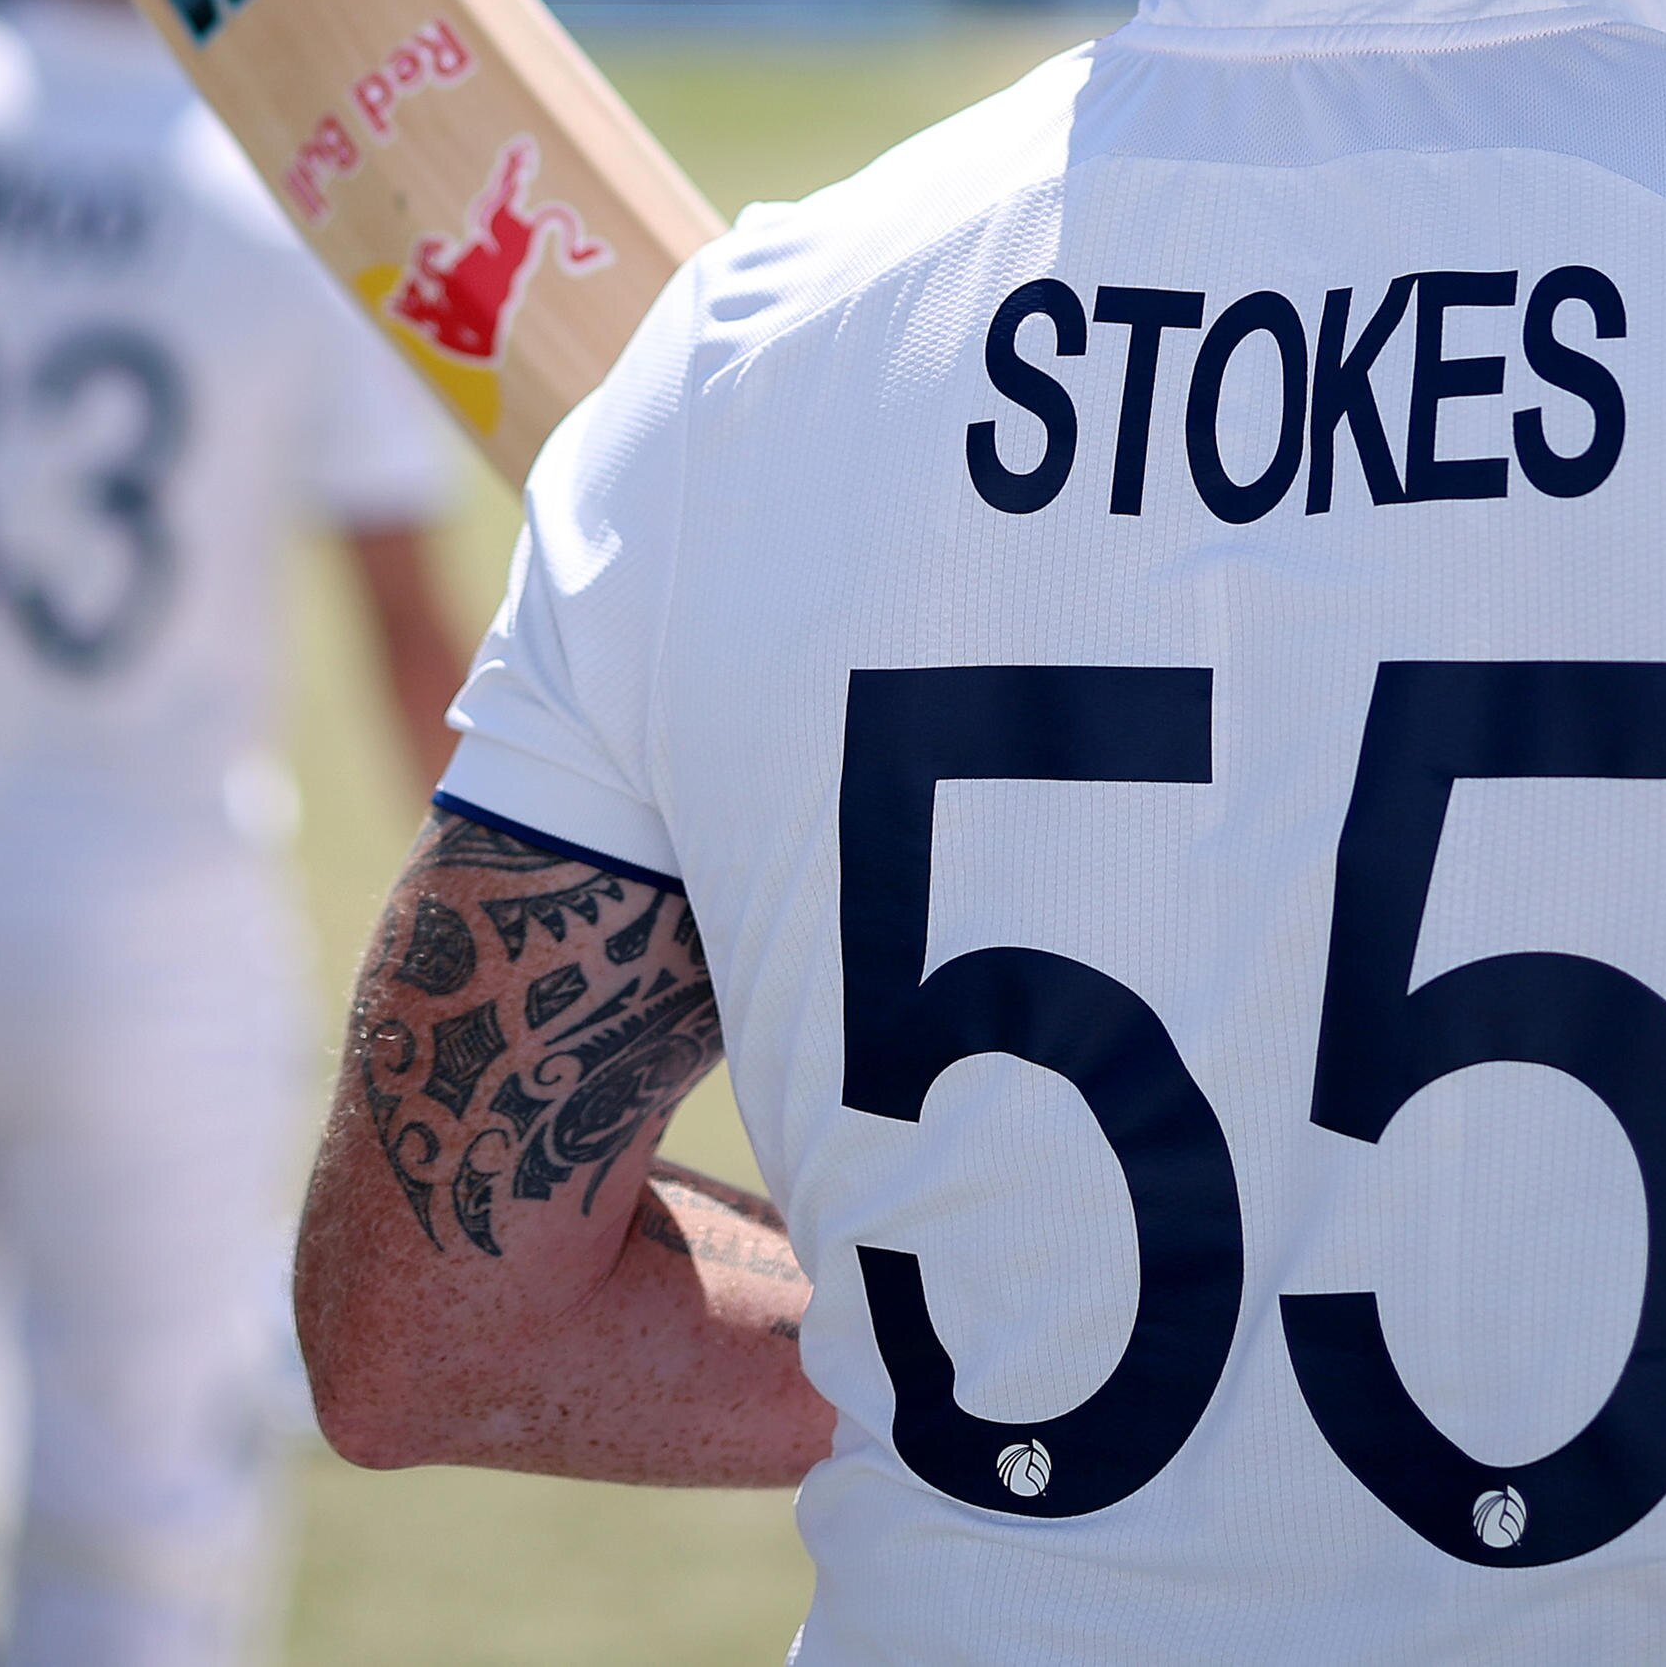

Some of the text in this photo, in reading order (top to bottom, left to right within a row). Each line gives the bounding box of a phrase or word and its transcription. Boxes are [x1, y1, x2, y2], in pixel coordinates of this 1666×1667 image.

[288, 16, 471, 222] Red Bull
[964, 264, 1628, 525] STOKES
